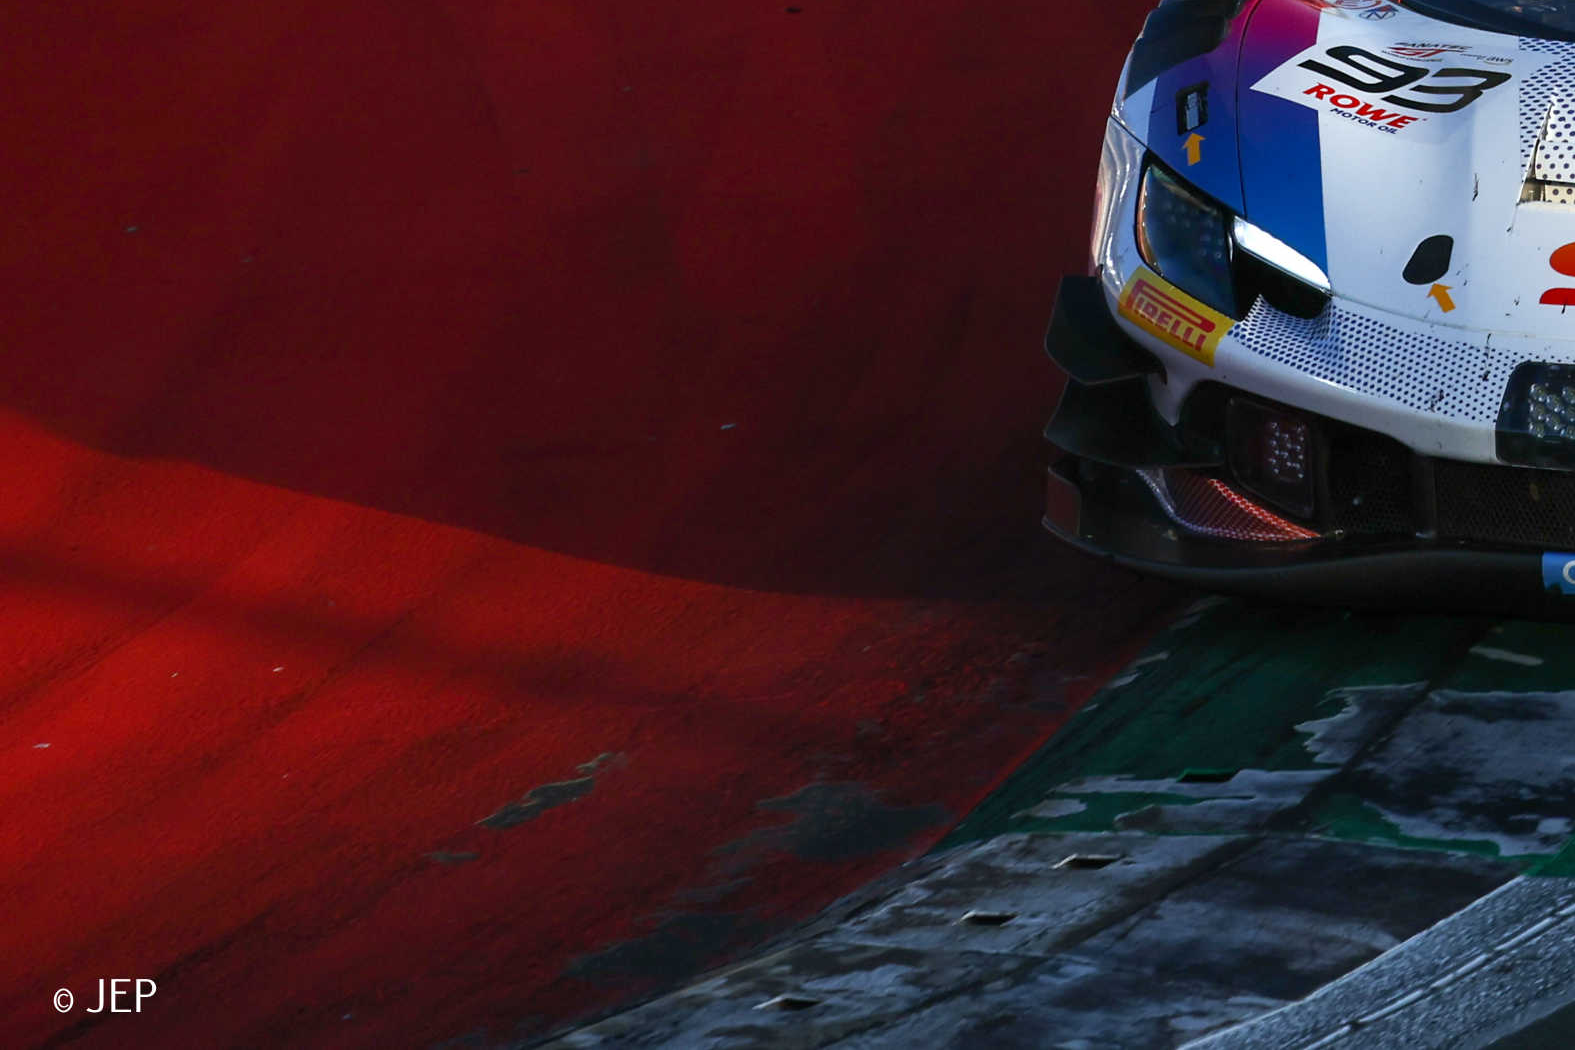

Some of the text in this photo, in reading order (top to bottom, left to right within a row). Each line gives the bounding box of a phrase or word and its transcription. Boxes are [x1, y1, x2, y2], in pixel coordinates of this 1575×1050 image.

[1297, 45, 1512, 113] 93
[1303, 82, 1419, 129] ROWE
[1330, 107, 1399, 135] MOTOR OIL
[1127, 278, 1216, 351] PIRELLI
